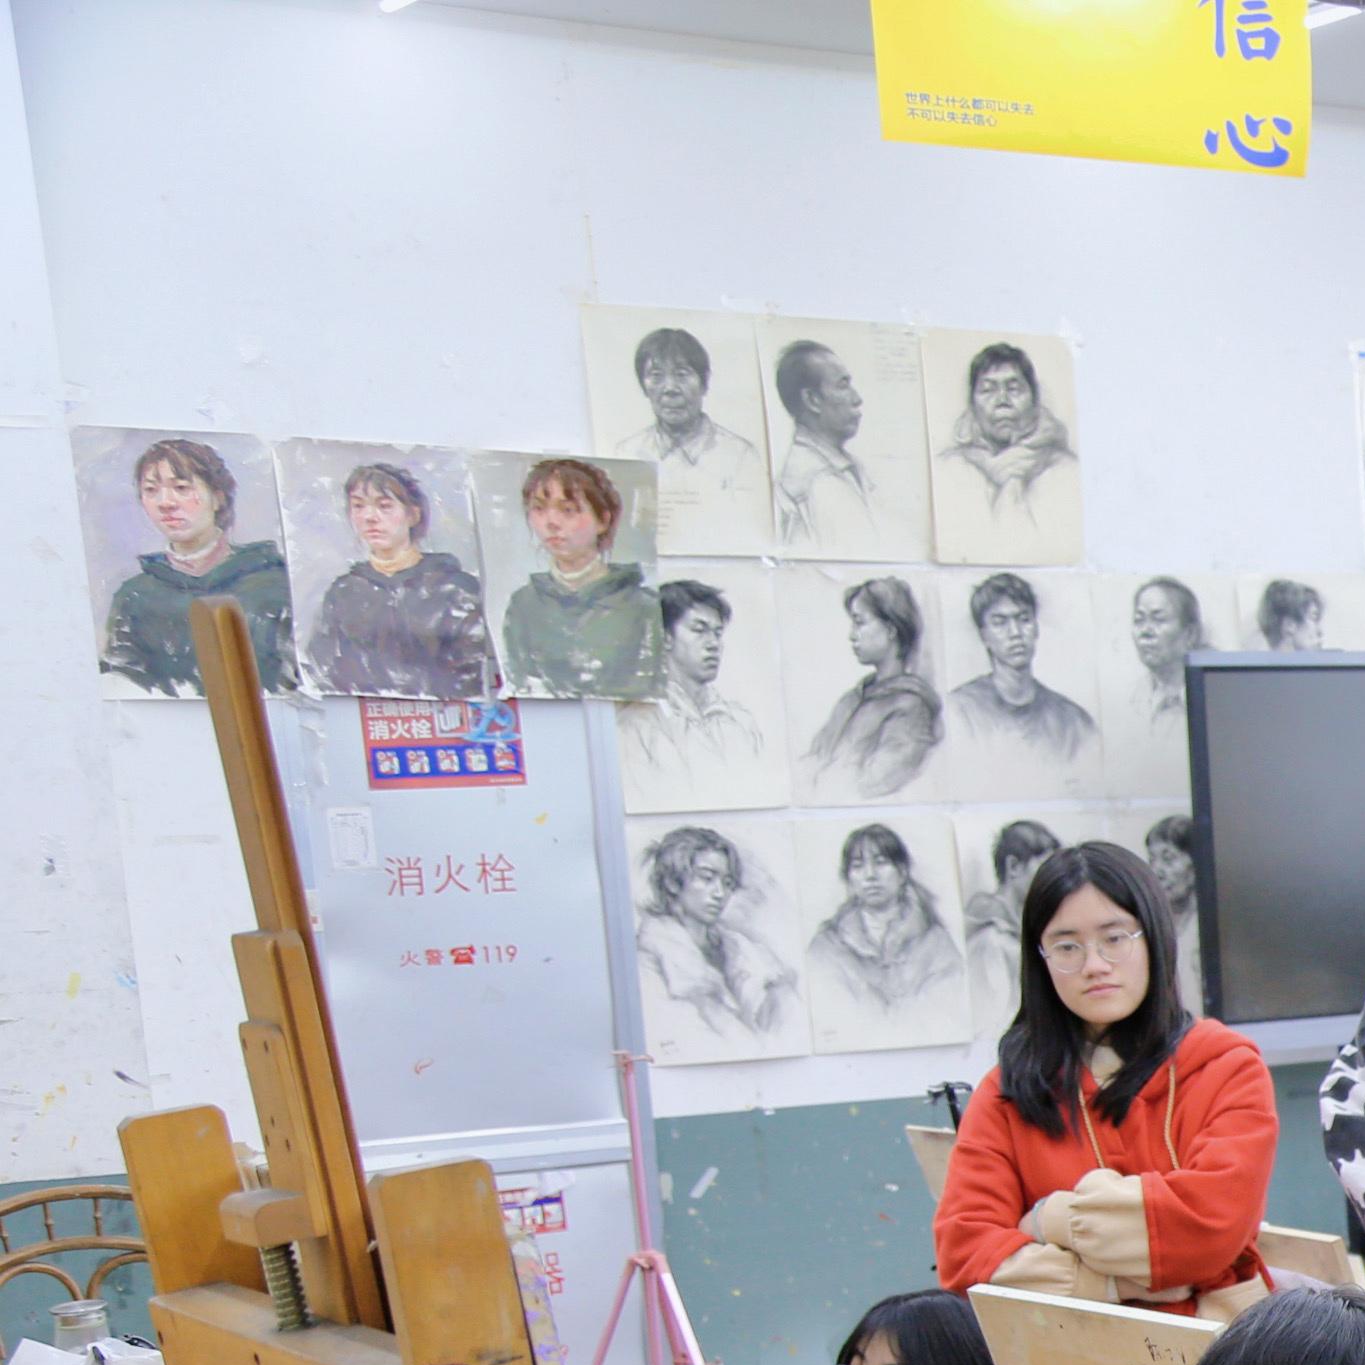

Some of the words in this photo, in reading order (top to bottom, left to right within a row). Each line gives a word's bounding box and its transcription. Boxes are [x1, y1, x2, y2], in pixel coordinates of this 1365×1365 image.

[1197, 0, 1293, 168] 信心
[905, 91, 1035, 115] 世界上什么都可以失去
[907, 107, 998, 127] 不可以失去信心
[369, 719, 433, 741] 消火栓
[384, 853, 518, 897] 消火栓
[400, 948, 444, 967] 火警
[483, 945, 518, 963] 119
